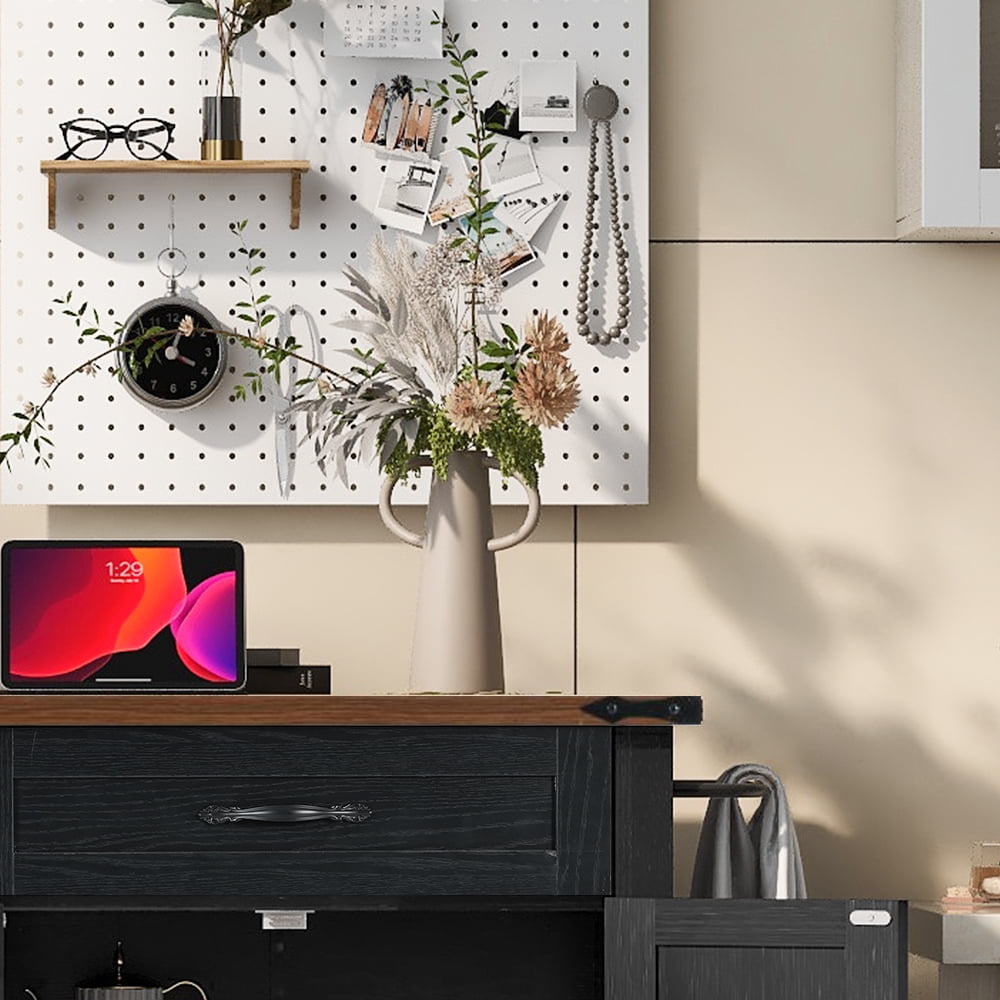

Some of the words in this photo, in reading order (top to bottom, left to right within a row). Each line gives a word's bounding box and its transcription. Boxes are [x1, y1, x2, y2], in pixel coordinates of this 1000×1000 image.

[167, 313, 180, 323] 12
[204, 347, 212, 357] 3
[201, 367, 208, 376] 4
[150, 380, 158, 390] 7
[170, 384, 177, 393] 6
[190, 381, 197, 390] 5
[105, 561, 144, 577] 1:29
